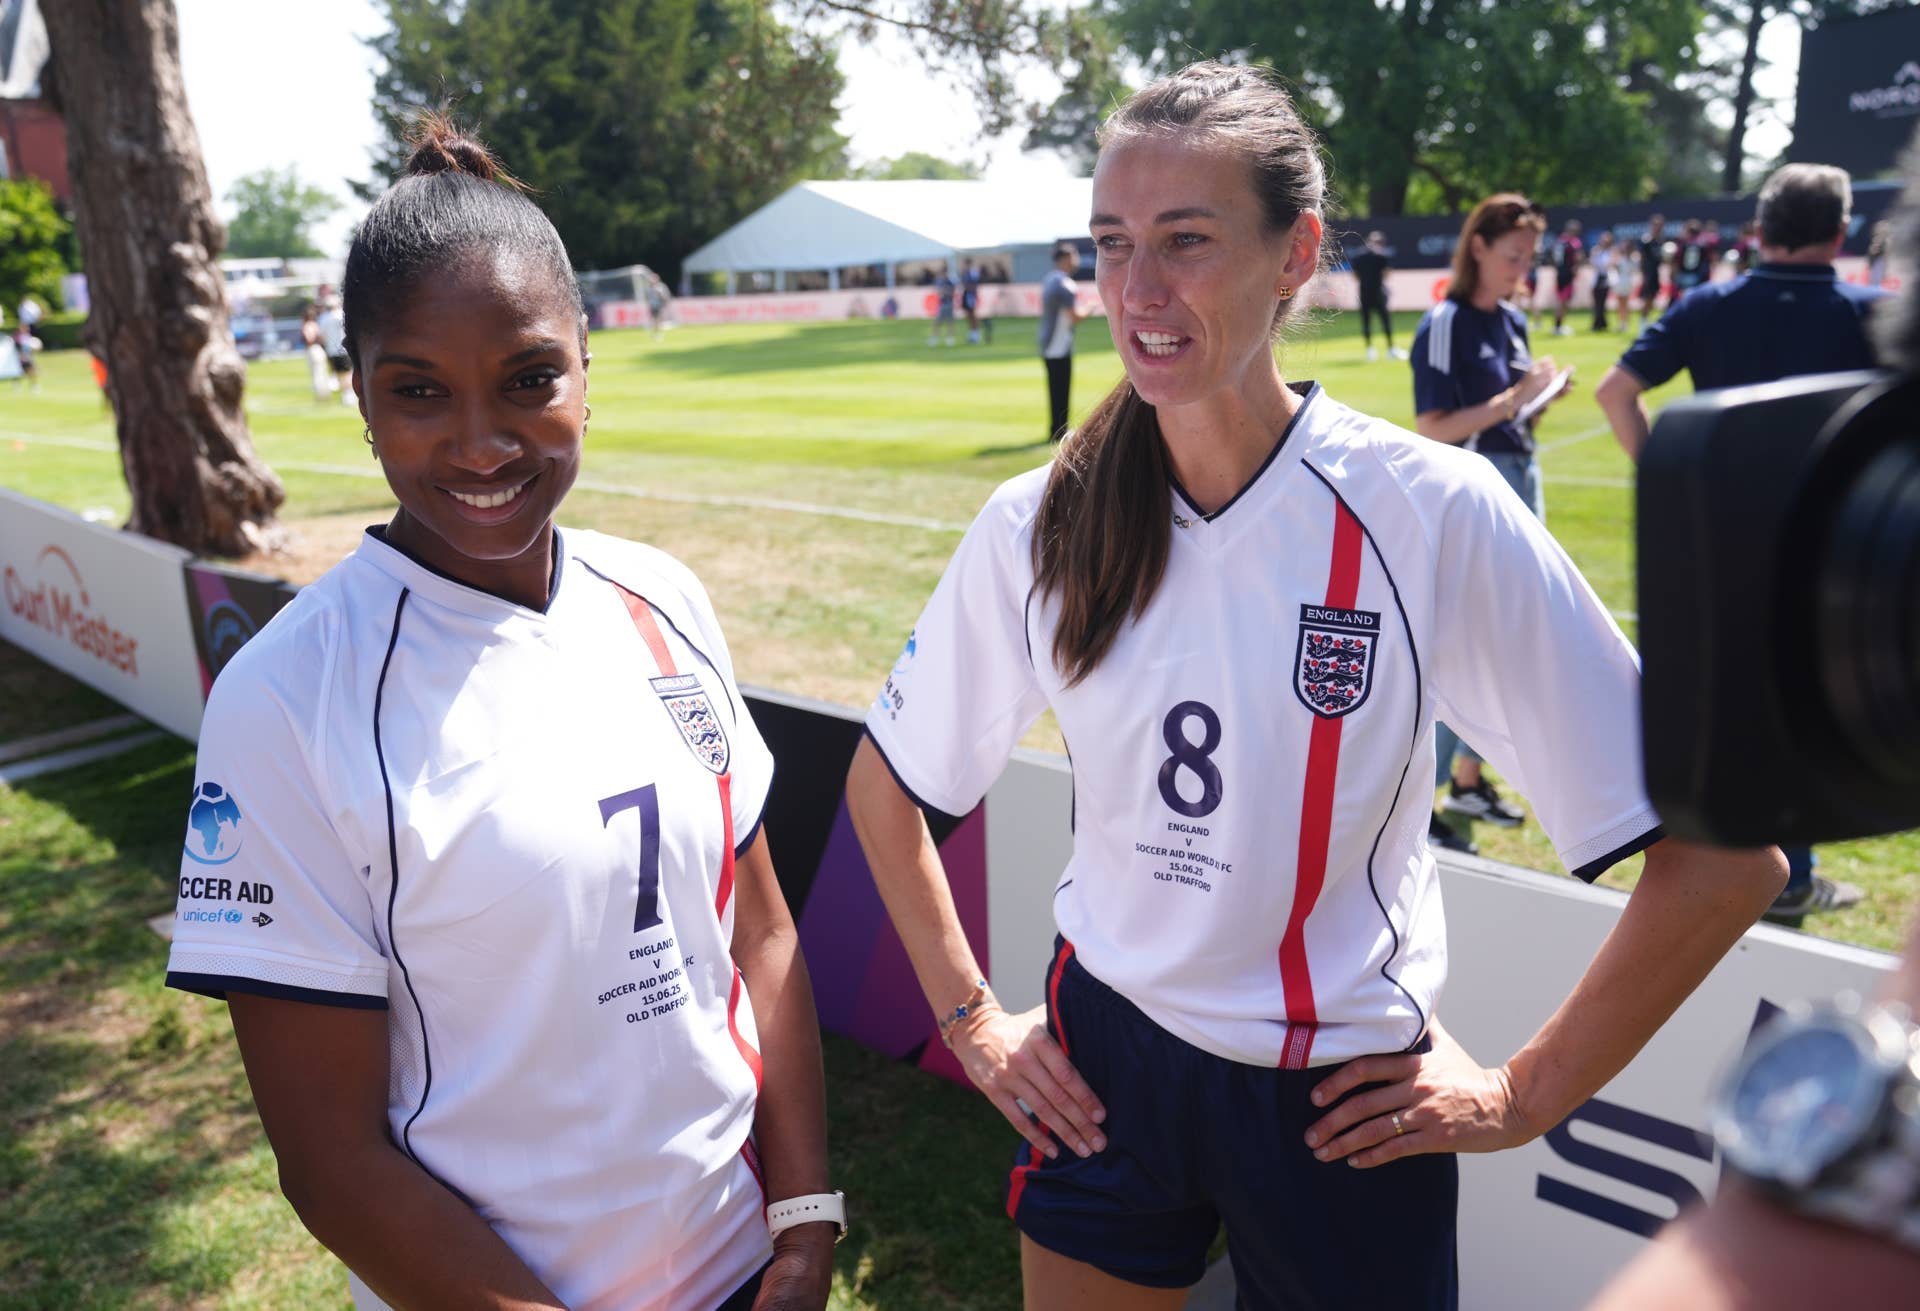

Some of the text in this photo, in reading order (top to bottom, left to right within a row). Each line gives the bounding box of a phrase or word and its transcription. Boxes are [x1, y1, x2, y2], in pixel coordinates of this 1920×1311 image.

[3, 565, 139, 678] Curl Master
[1306, 608, 1373, 625] ENGLAND
[1158, 701, 1222, 818] 8
[1168, 823, 1209, 836] ENGLAND
[1185, 838, 1193, 847] V
[598, 783, 664, 933] 7
[1136, 843, 1167, 856] SOCCER
[1169, 849, 1186, 859] AID
[1187, 852, 1214, 866] WORLD
[1221, 864, 1232, 872] FC
[1169, 862, 1203, 876] 15.06.25
[180, 877, 274, 905] CCER AID
[1153, 871, 1211, 892] OLD TRAFFORD
[183, 907, 225, 923] unicef
[629, 937, 674, 960] ENGLAND
[653, 958, 661, 969] V
[598, 982, 637, 1005] SOCCER
[639, 977, 657, 991] AID
[658, 968, 682, 984] WORL
[685, 955, 694, 967] FC
[641, 984, 681, 1006] 15.06.25
[626, 993, 689, 1024] OLD TRAFFOR
